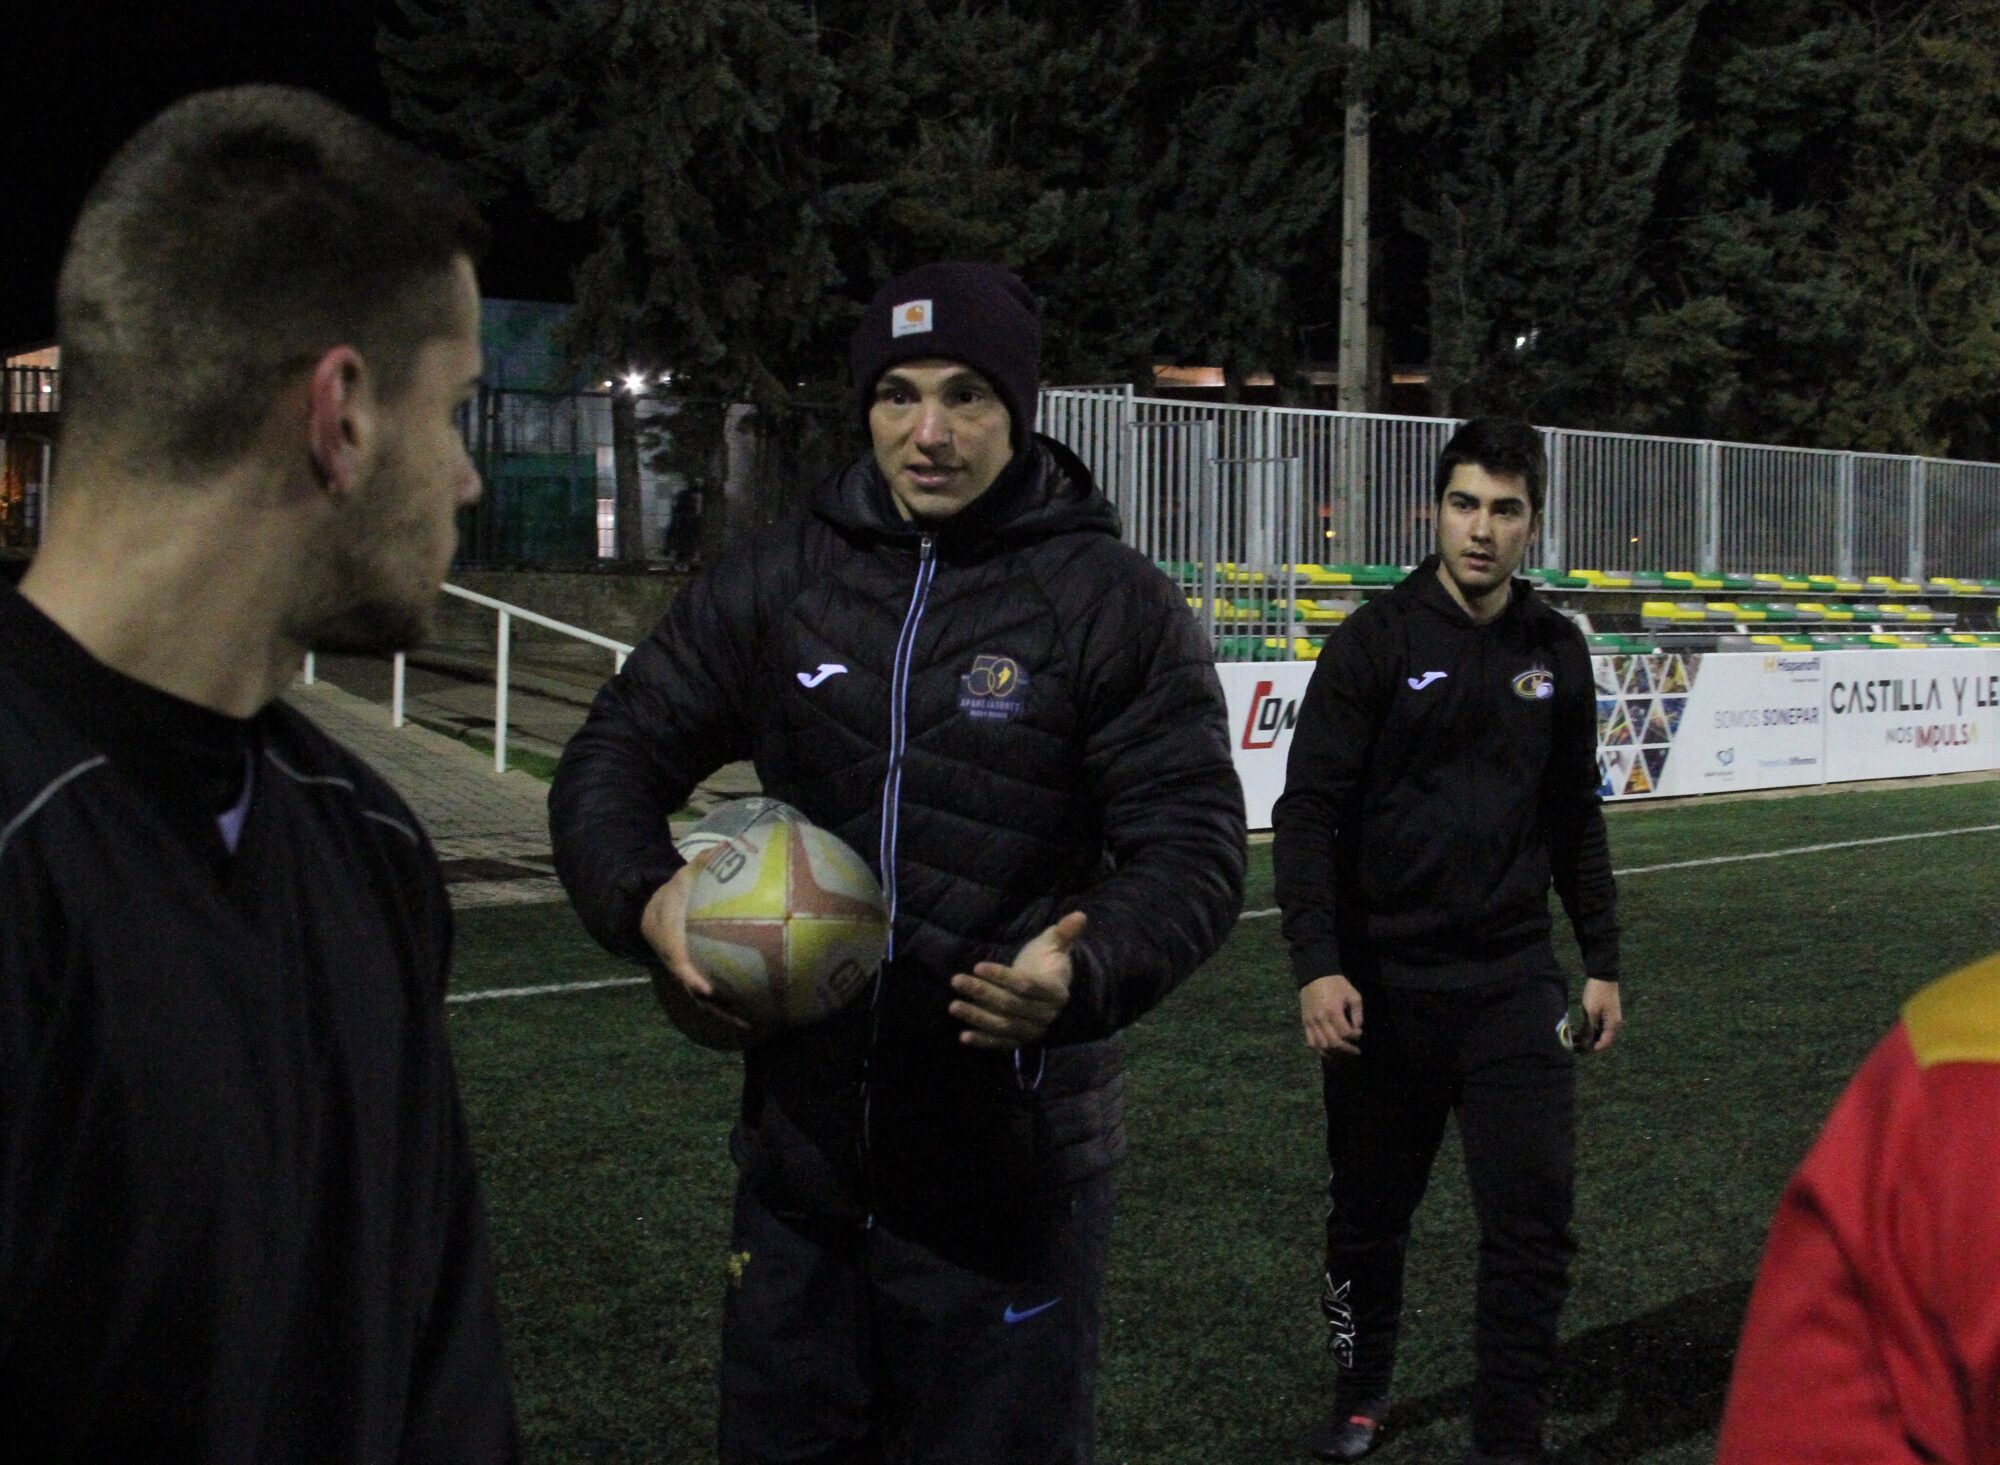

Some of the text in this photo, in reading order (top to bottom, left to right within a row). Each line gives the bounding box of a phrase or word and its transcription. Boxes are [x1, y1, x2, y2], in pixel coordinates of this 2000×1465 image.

[1830, 678, 1942, 714] CASTILLA
[1952, 676, 1968, 717] Y
[1714, 706, 1819, 729] SOMOS SONEPAR
